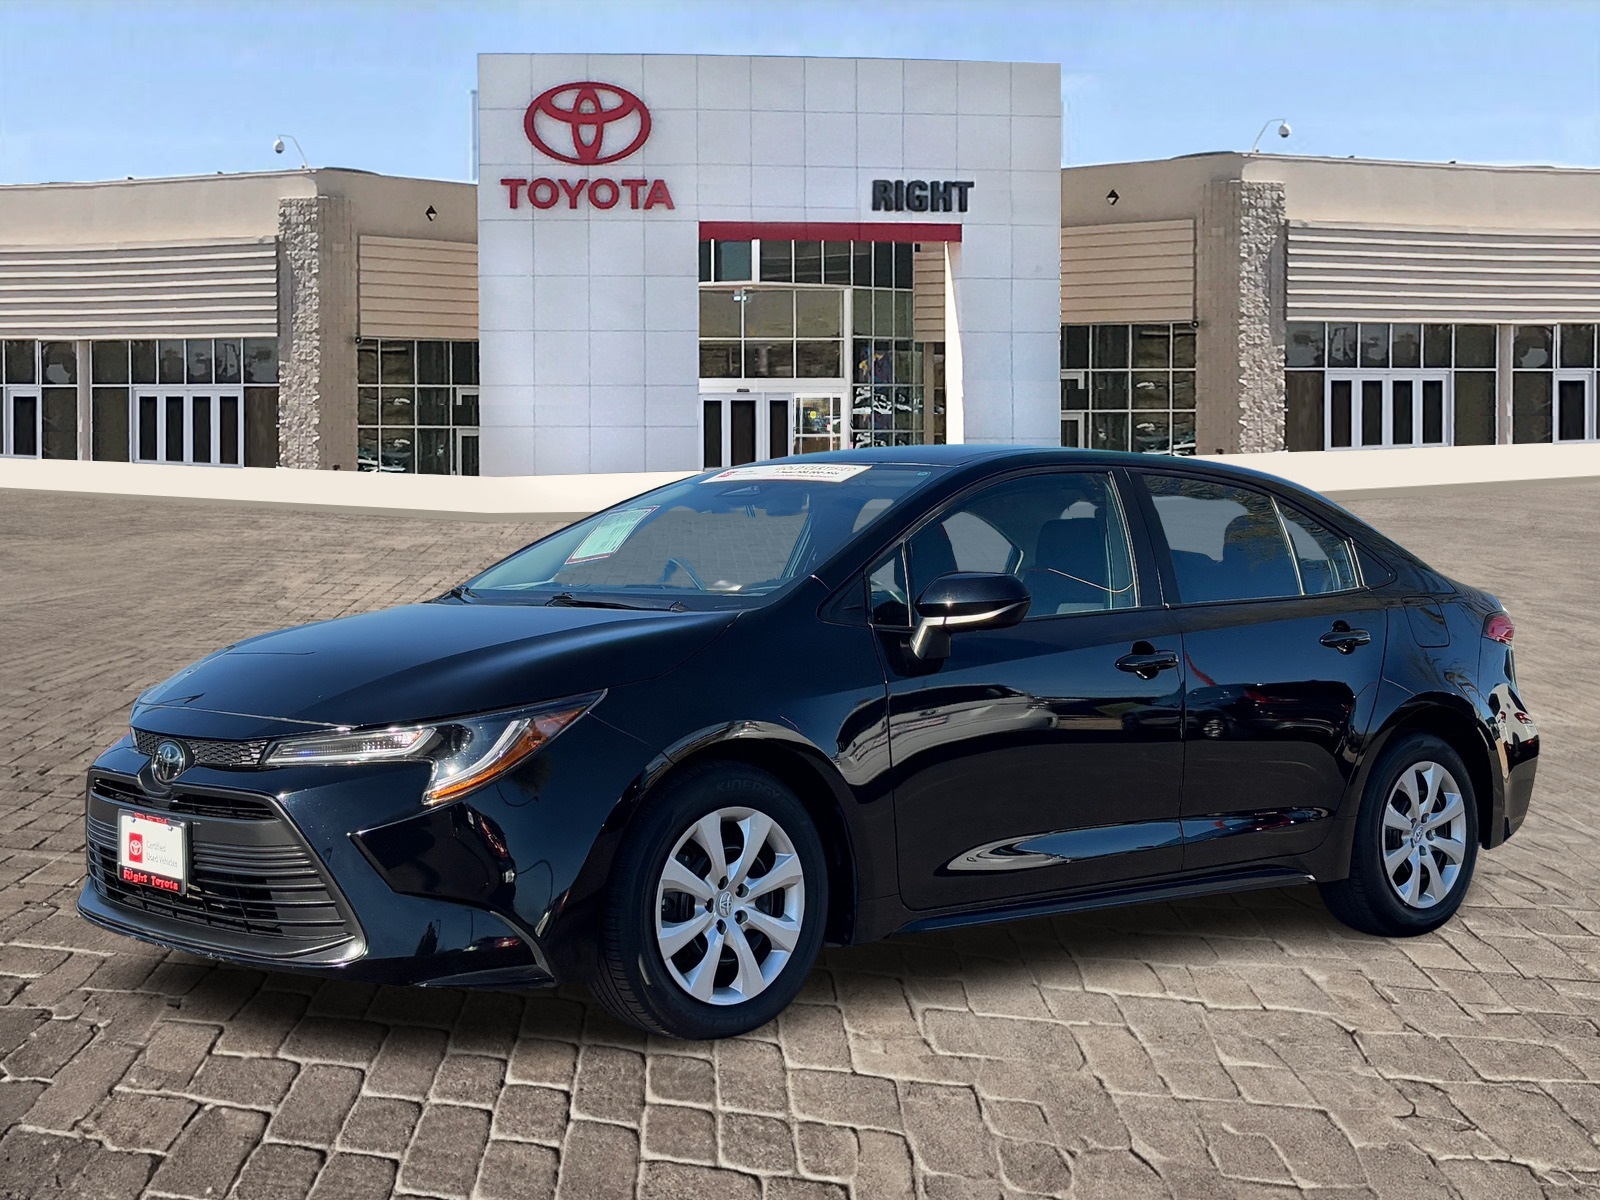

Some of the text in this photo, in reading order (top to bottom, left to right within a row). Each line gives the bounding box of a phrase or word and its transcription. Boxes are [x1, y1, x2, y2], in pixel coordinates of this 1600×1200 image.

[500, 177, 675, 210] TOYOTA
[871, 179, 975, 212] RIGHT
[123, 867, 179, 891] Right Toyota
